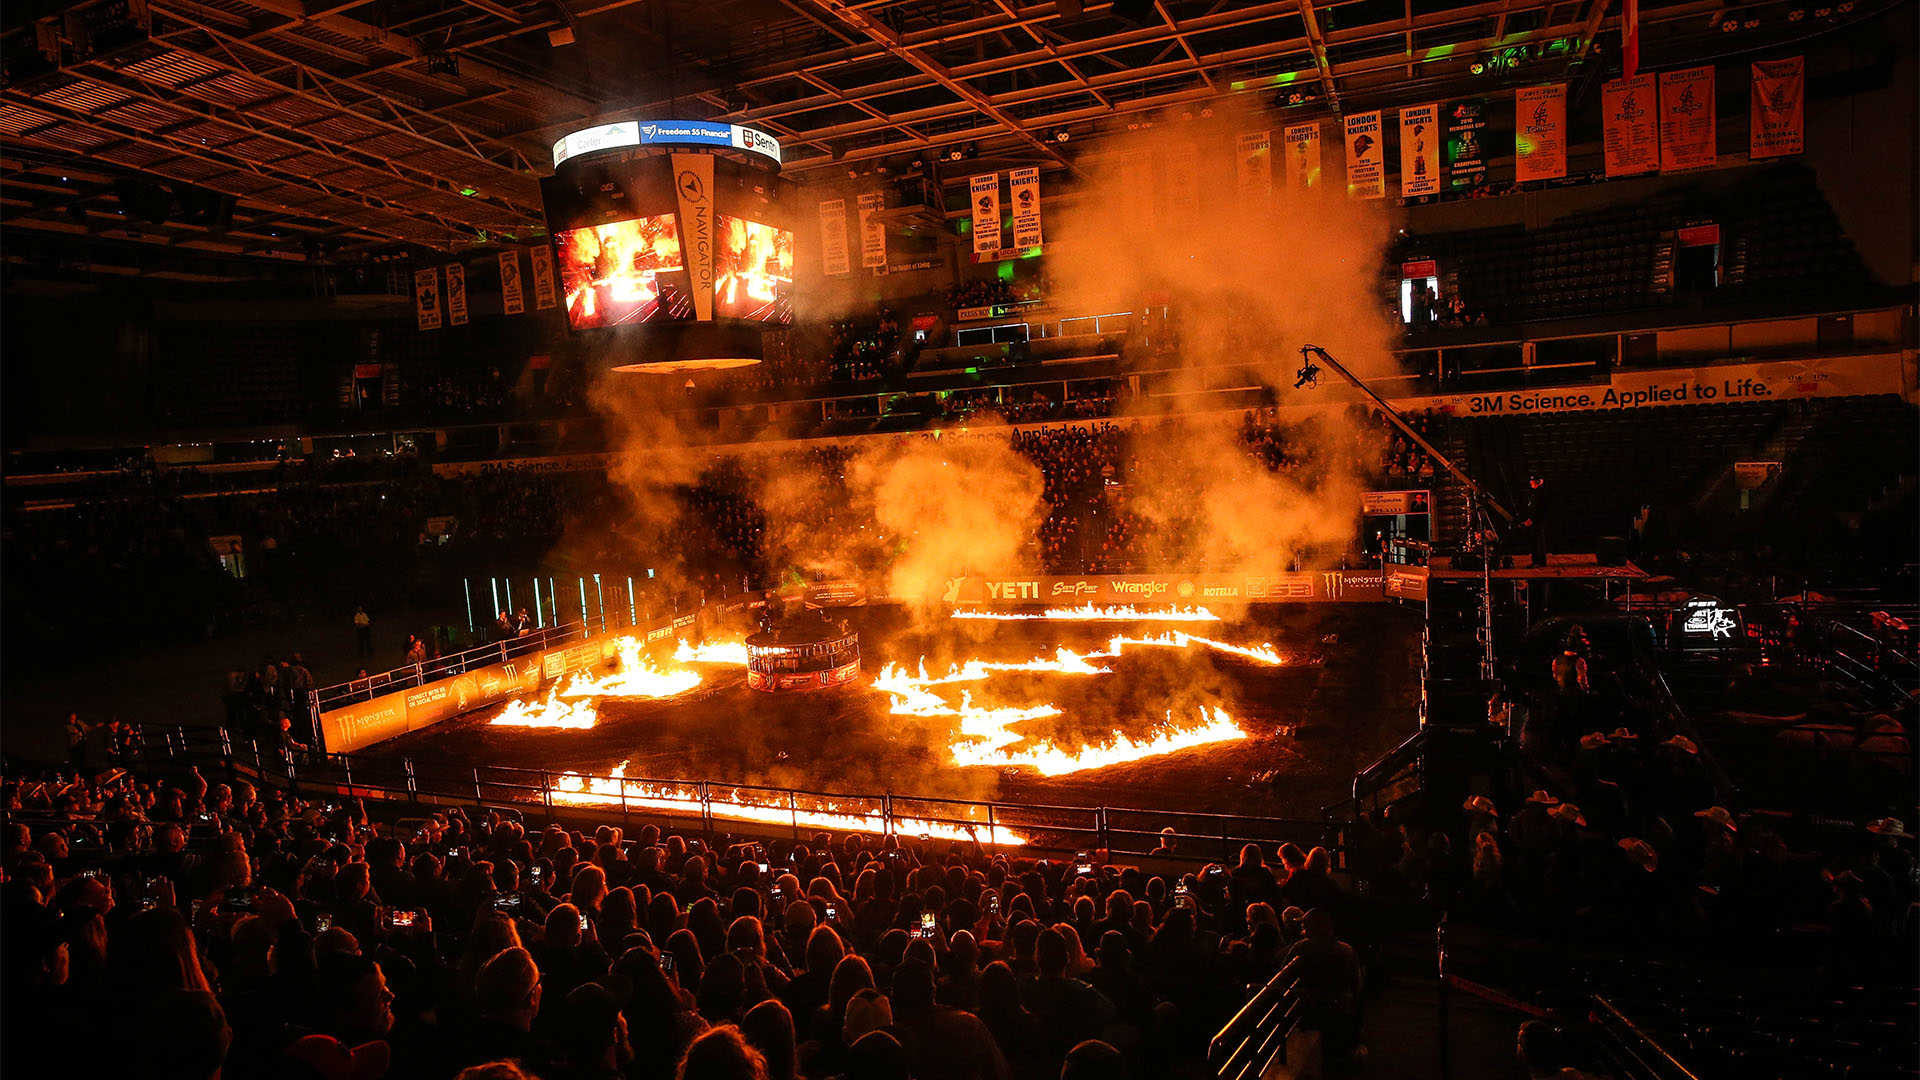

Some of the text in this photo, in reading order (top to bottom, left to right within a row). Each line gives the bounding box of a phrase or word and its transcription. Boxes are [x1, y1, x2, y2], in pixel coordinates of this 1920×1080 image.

[1406, 108, 1431, 117] LONDON
[1347, 114, 1377, 127] LONDON
[1404, 116, 1433, 126] KNIGHTS
[658, 128, 691, 136] Freedom
[1347, 123, 1378, 135] KNIGHTS
[1286, 131, 1319, 143] KNIGHTS
[971, 182, 998, 192] KNIGHTS
[1010, 176, 1039, 186] KNIGHTS
[695, 206, 712, 289] NAVIGATOR
[1470, 395, 1503, 412] 3M
[1508, 393, 1595, 411] Science.
[1602, 383, 1687, 408] Applied
[1693, 383, 1717, 399] to
[1725, 378, 1772, 397] Life.
[1011, 423, 1067, 441] Applied
[1071, 425, 1088, 438] to
[985, 581, 1040, 599] YETI
[1111, 580, 1168, 598] Wrangler
[1203, 587, 1239, 597] ROTELLA
[647, 627, 672, 641] PBR
[407, 691, 428, 702] CONNECT
[356, 708, 395, 725] MONSTER
